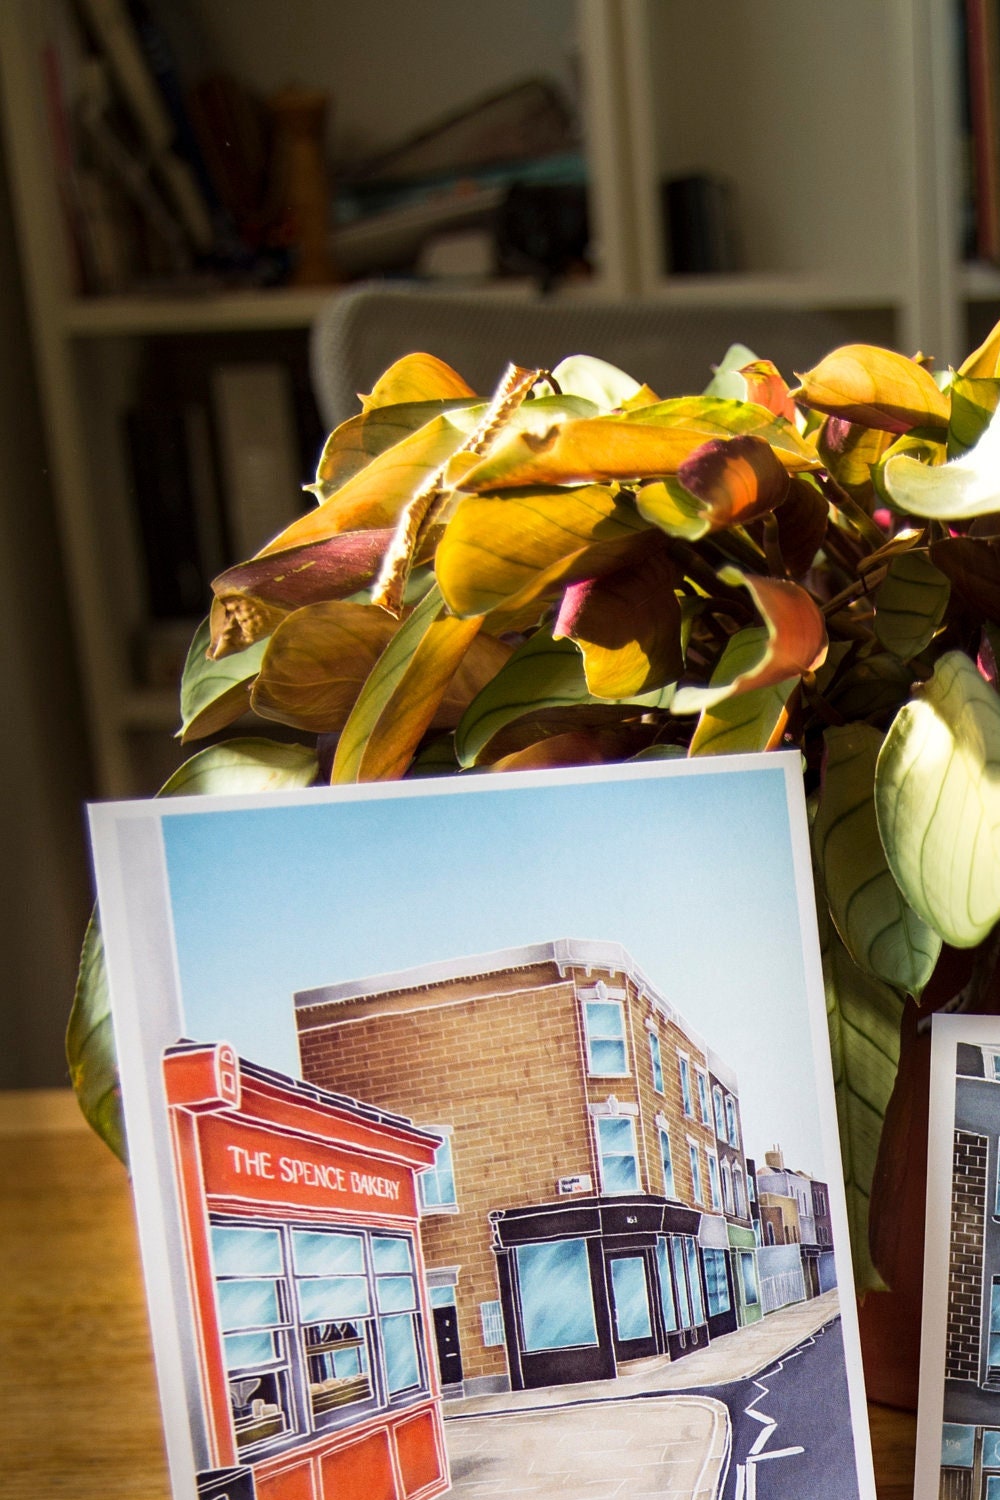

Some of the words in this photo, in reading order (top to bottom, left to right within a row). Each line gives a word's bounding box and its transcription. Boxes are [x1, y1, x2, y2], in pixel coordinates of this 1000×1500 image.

[227, 1145, 275, 1180] THE
[279, 1156, 347, 1192] SPENCE
[350, 1171, 400, 1201] BAKERY
